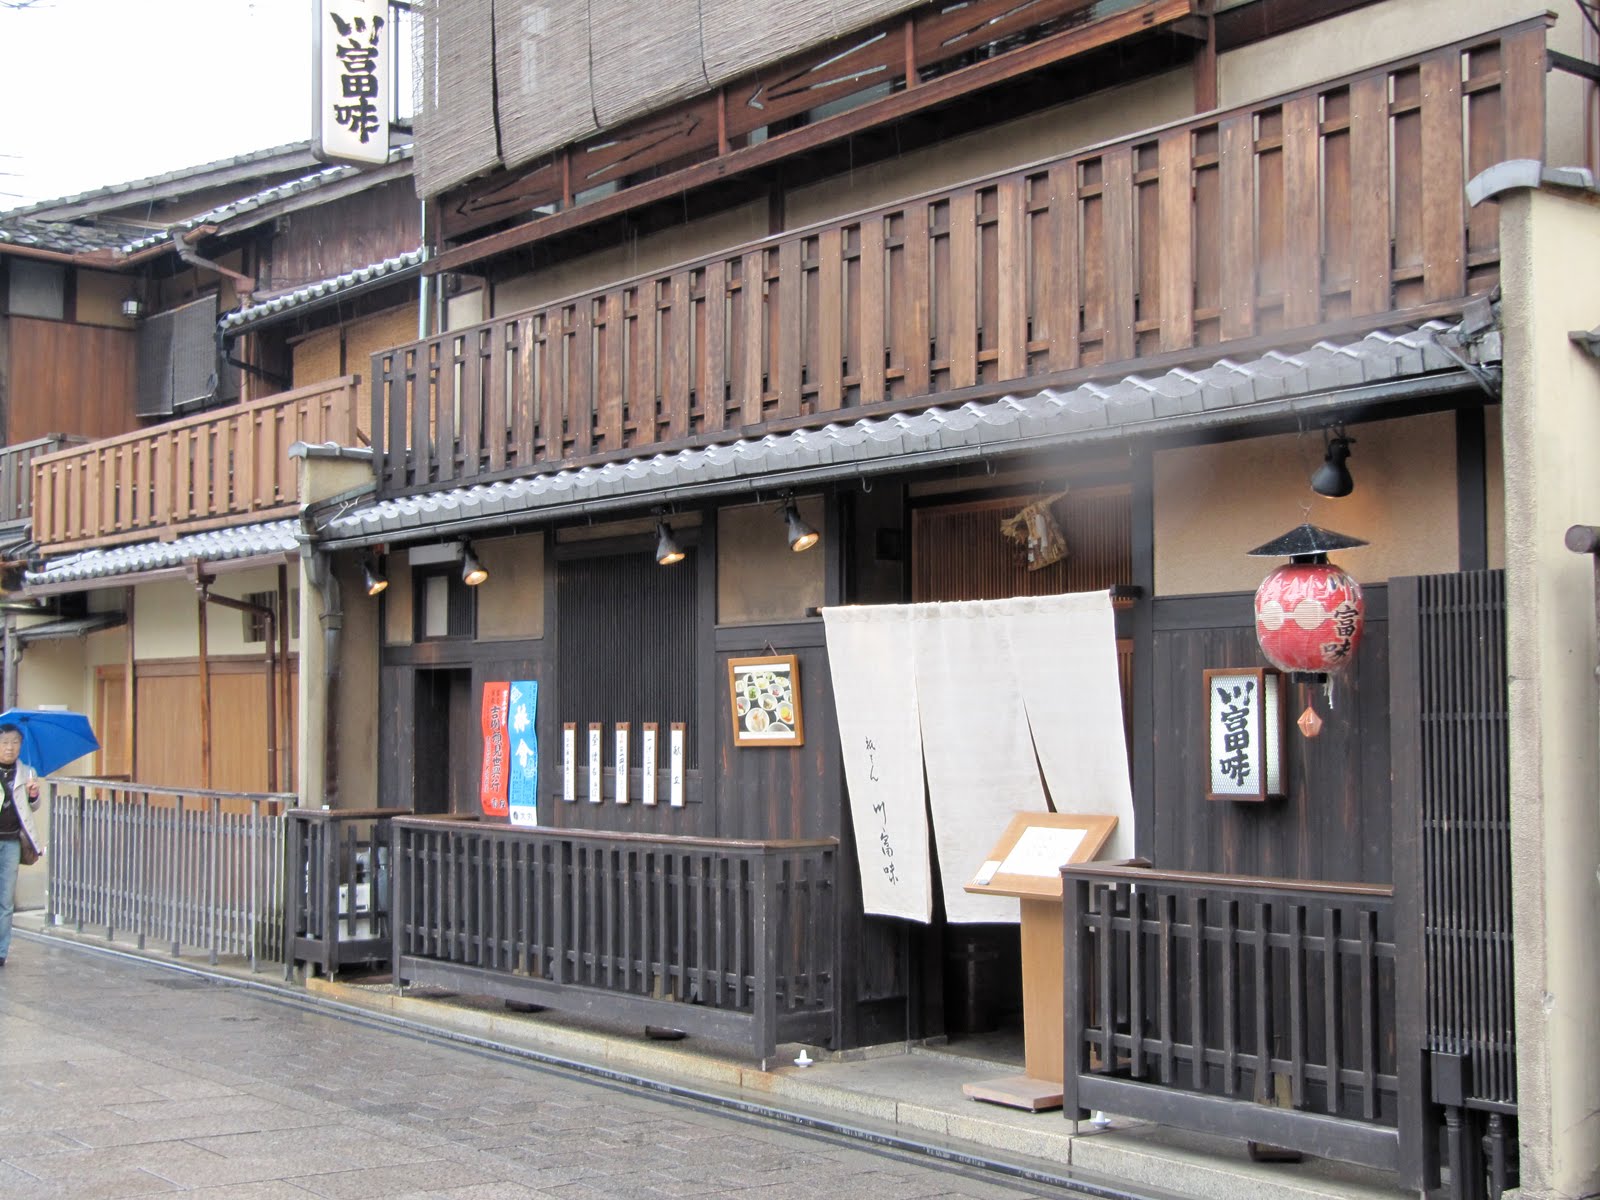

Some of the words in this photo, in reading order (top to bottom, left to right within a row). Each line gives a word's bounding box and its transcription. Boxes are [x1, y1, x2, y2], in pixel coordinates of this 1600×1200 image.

[330, 12, 385, 144] 川富味
[1323, 573, 1359, 661] 川富味
[1216, 681, 1254, 787] 川富味
